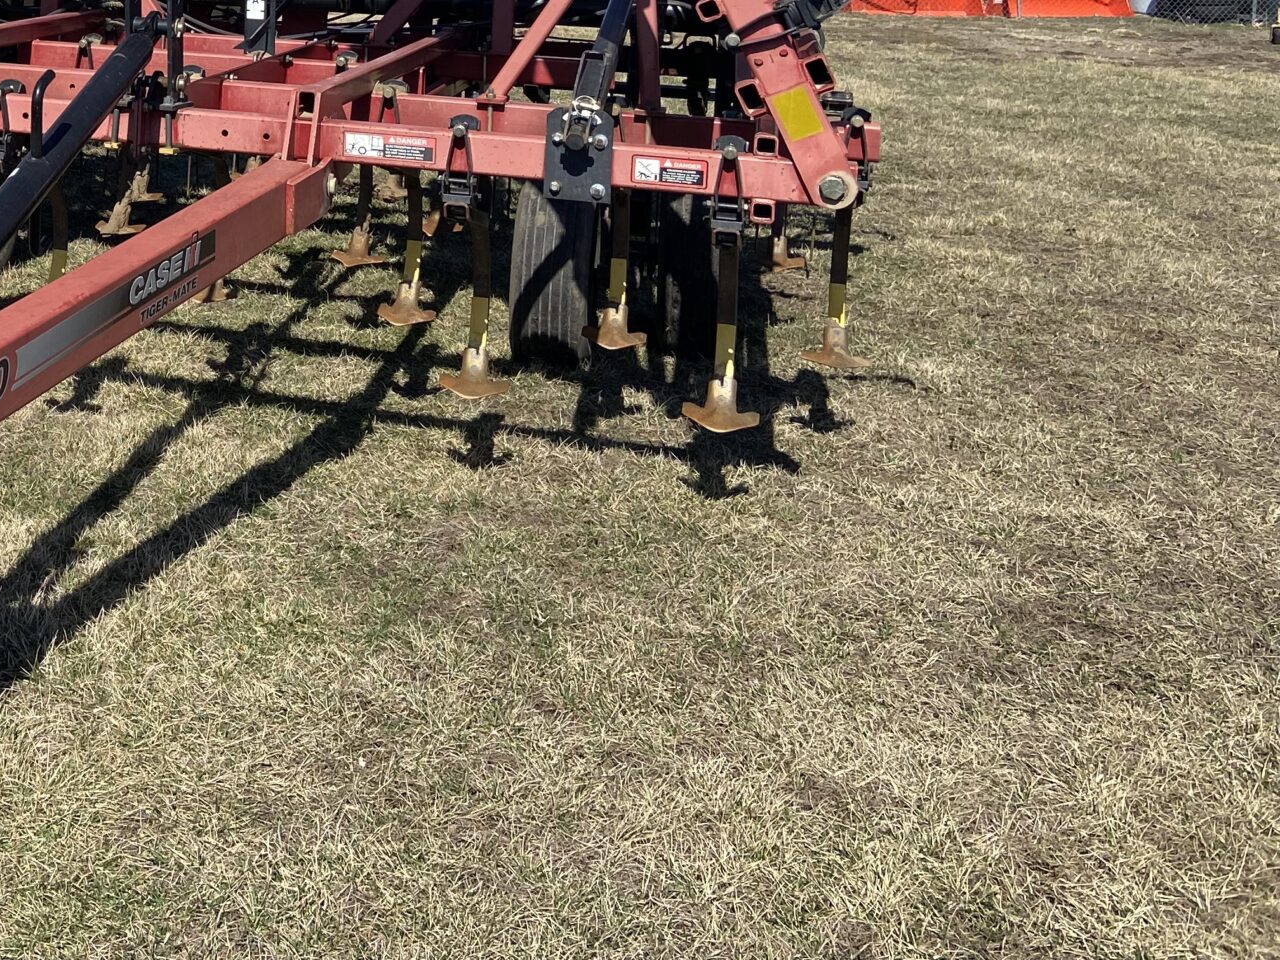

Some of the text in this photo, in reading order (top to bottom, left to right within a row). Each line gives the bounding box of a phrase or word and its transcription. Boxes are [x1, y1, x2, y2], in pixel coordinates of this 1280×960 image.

[396, 137, 427, 145] DANGER
[673, 161, 702, 169] DANGER
[129, 250, 184, 305] CASE
